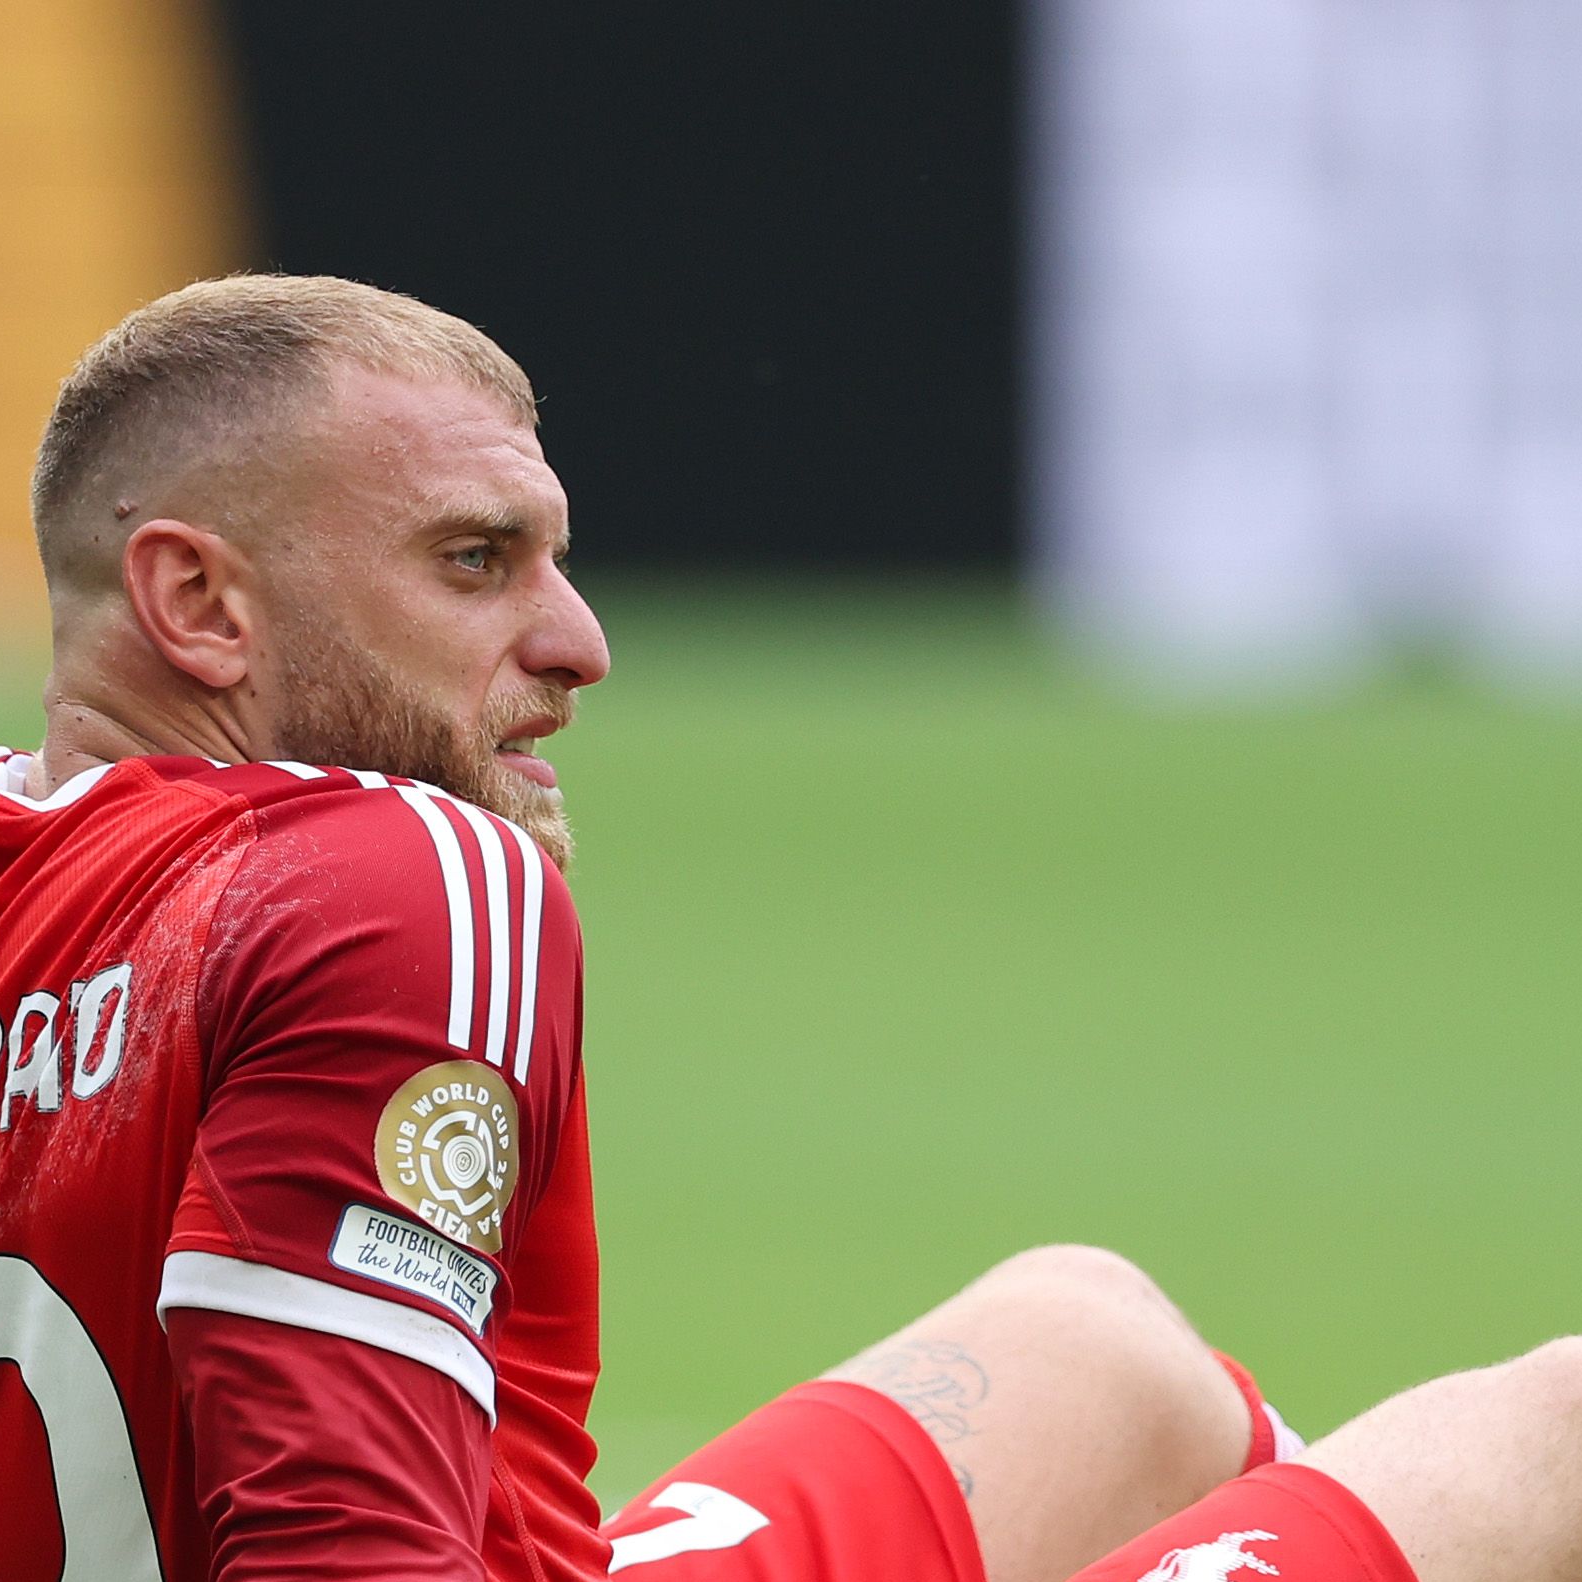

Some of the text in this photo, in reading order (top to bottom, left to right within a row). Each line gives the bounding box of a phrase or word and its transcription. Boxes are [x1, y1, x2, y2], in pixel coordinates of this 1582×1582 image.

[395, 1120, 418, 1186] CLUB
[410, 1083, 490, 1118] WORLD
[491, 1103, 510, 1150] CUP
[418, 1198, 469, 1245] FIFA
[357, 1243, 452, 1297] the World
[364, 1216, 490, 1295] FOOTBALL UNITES
